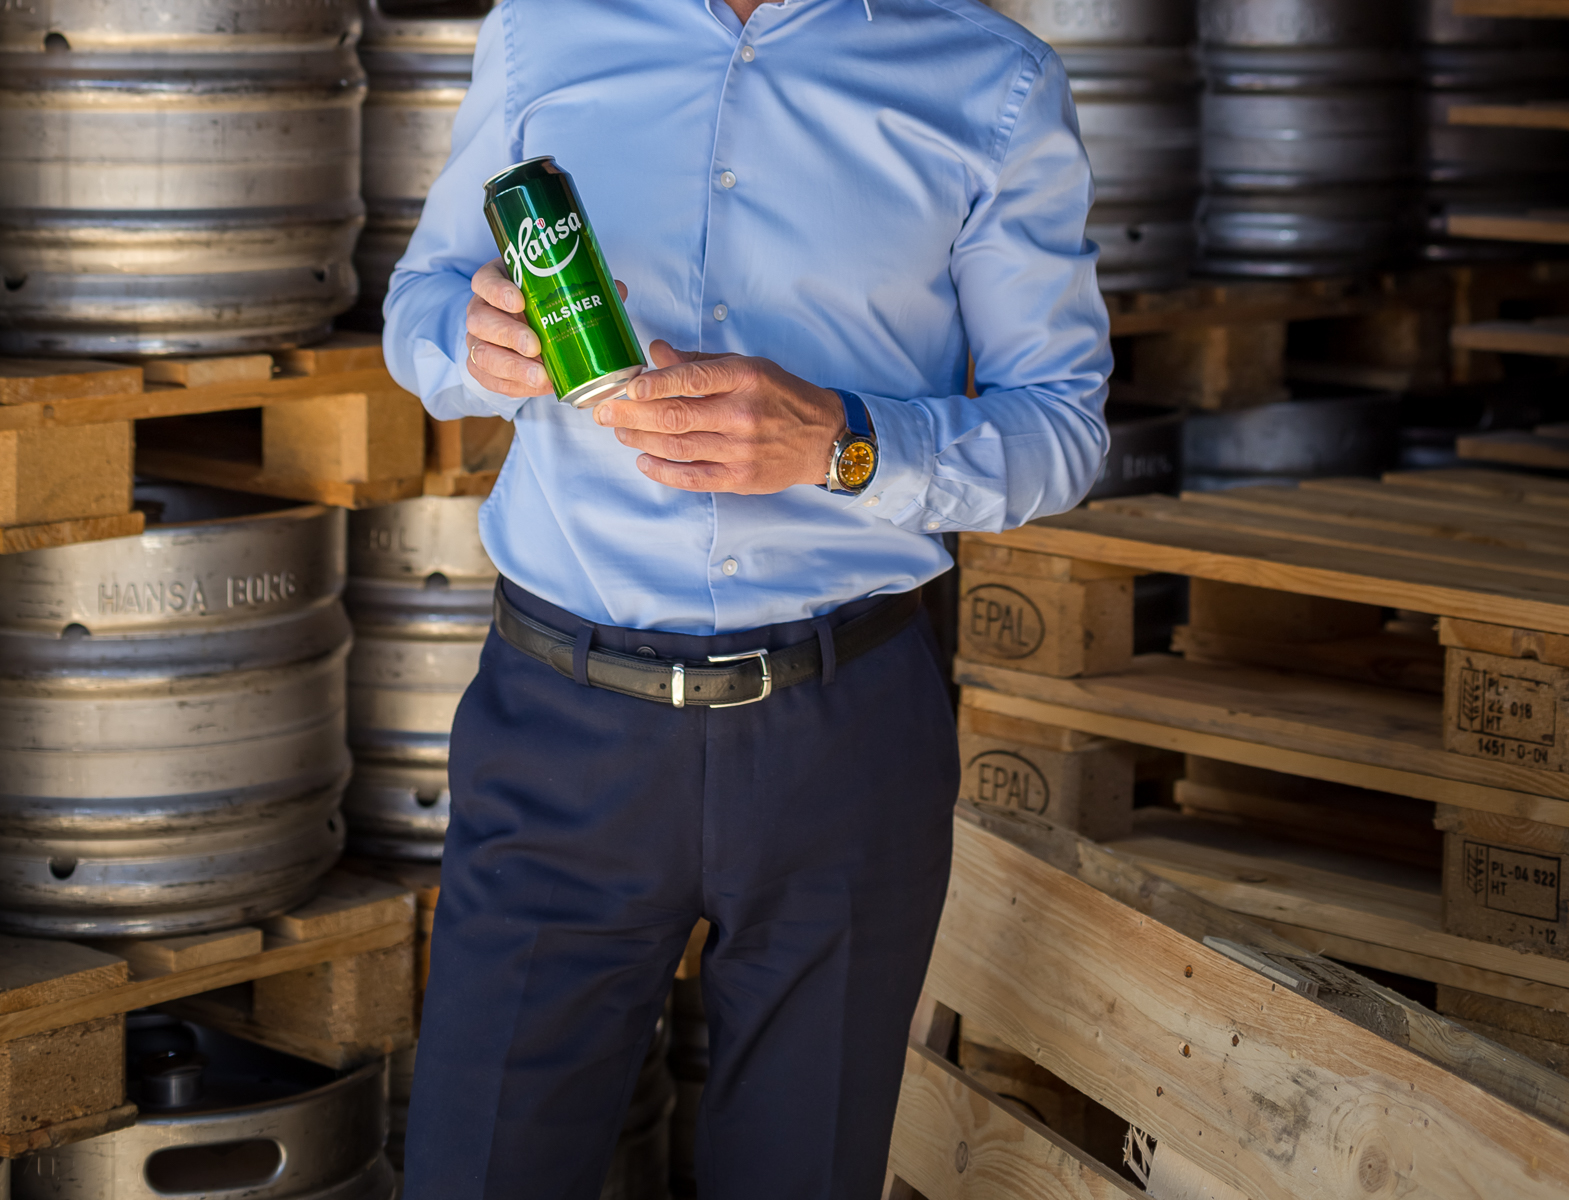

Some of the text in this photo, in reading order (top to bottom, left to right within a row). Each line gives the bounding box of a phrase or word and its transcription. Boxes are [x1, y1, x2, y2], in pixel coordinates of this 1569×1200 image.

[503, 212, 582, 290] Hansa
[540, 294, 603, 330] PILSNER
[97, 570, 297, 616] HANSA BORG
[970, 596, 1030, 647] EPAL
[1485, 714, 1503, 731] HT
[978, 762, 1038, 813] EPAL
[1490, 860, 1557, 889] PL-04 522
[1490, 880, 1508, 896] HT
